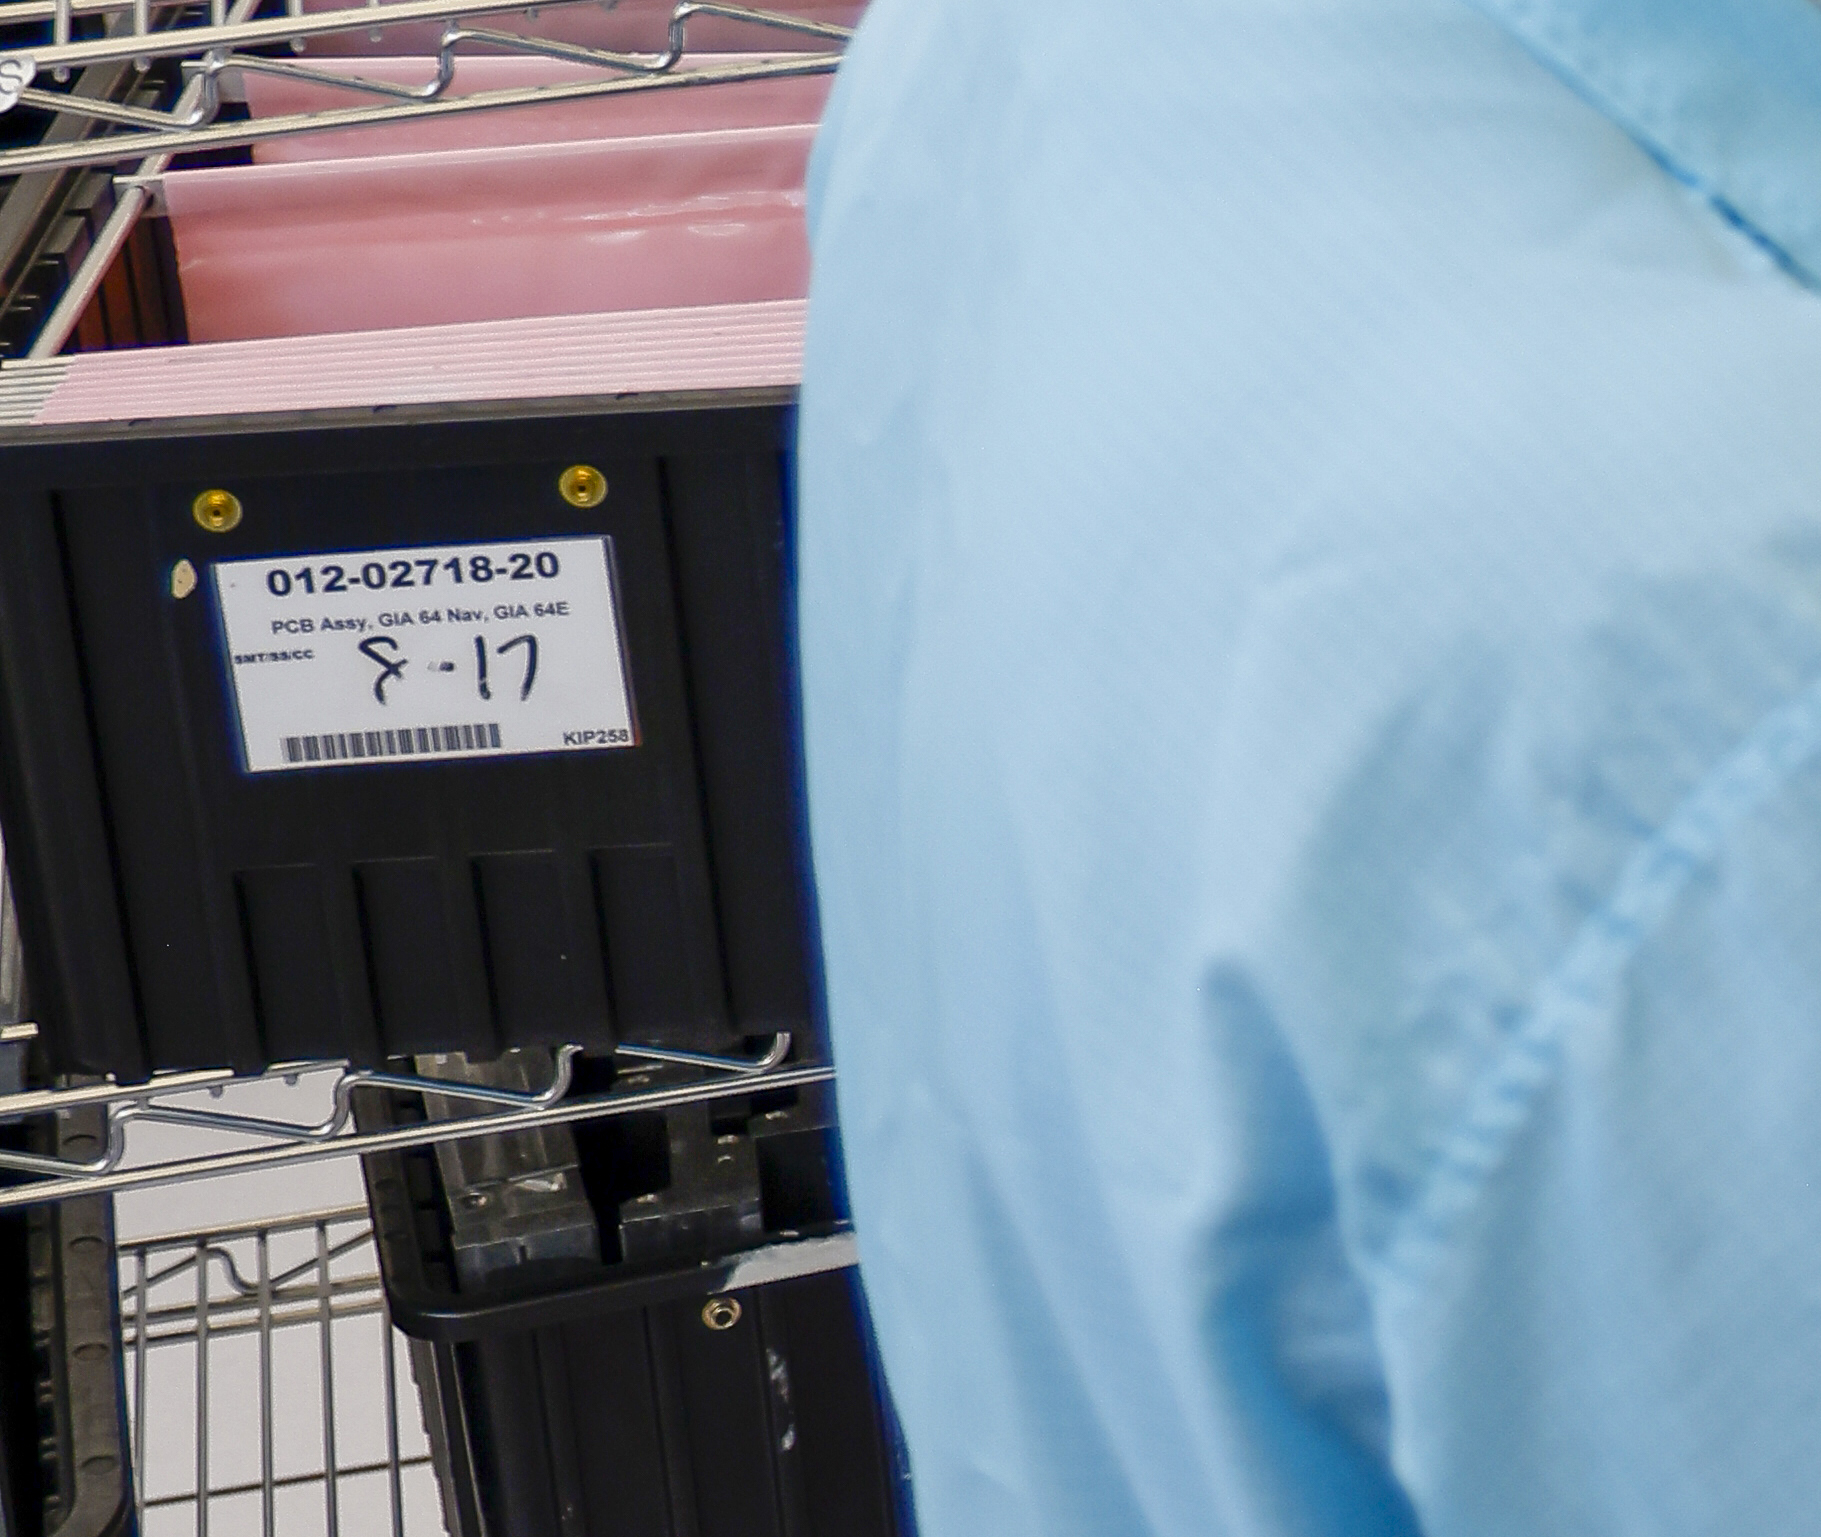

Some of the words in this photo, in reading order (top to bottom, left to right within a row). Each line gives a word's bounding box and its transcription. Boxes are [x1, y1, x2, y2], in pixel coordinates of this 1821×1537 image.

[265, 551, 561, 598] 012-02718-20
[270, 618, 314, 634] PCB
[320, 614, 373, 633] Assy,
[378, 611, 413, 629] GIA
[418, 609, 442, 624] 64
[447, 606, 489, 624] Nav,
[493, 603, 528, 620] GIA
[533, 600, 571, 618] 64E
[561, 727, 631, 746] KIP258
